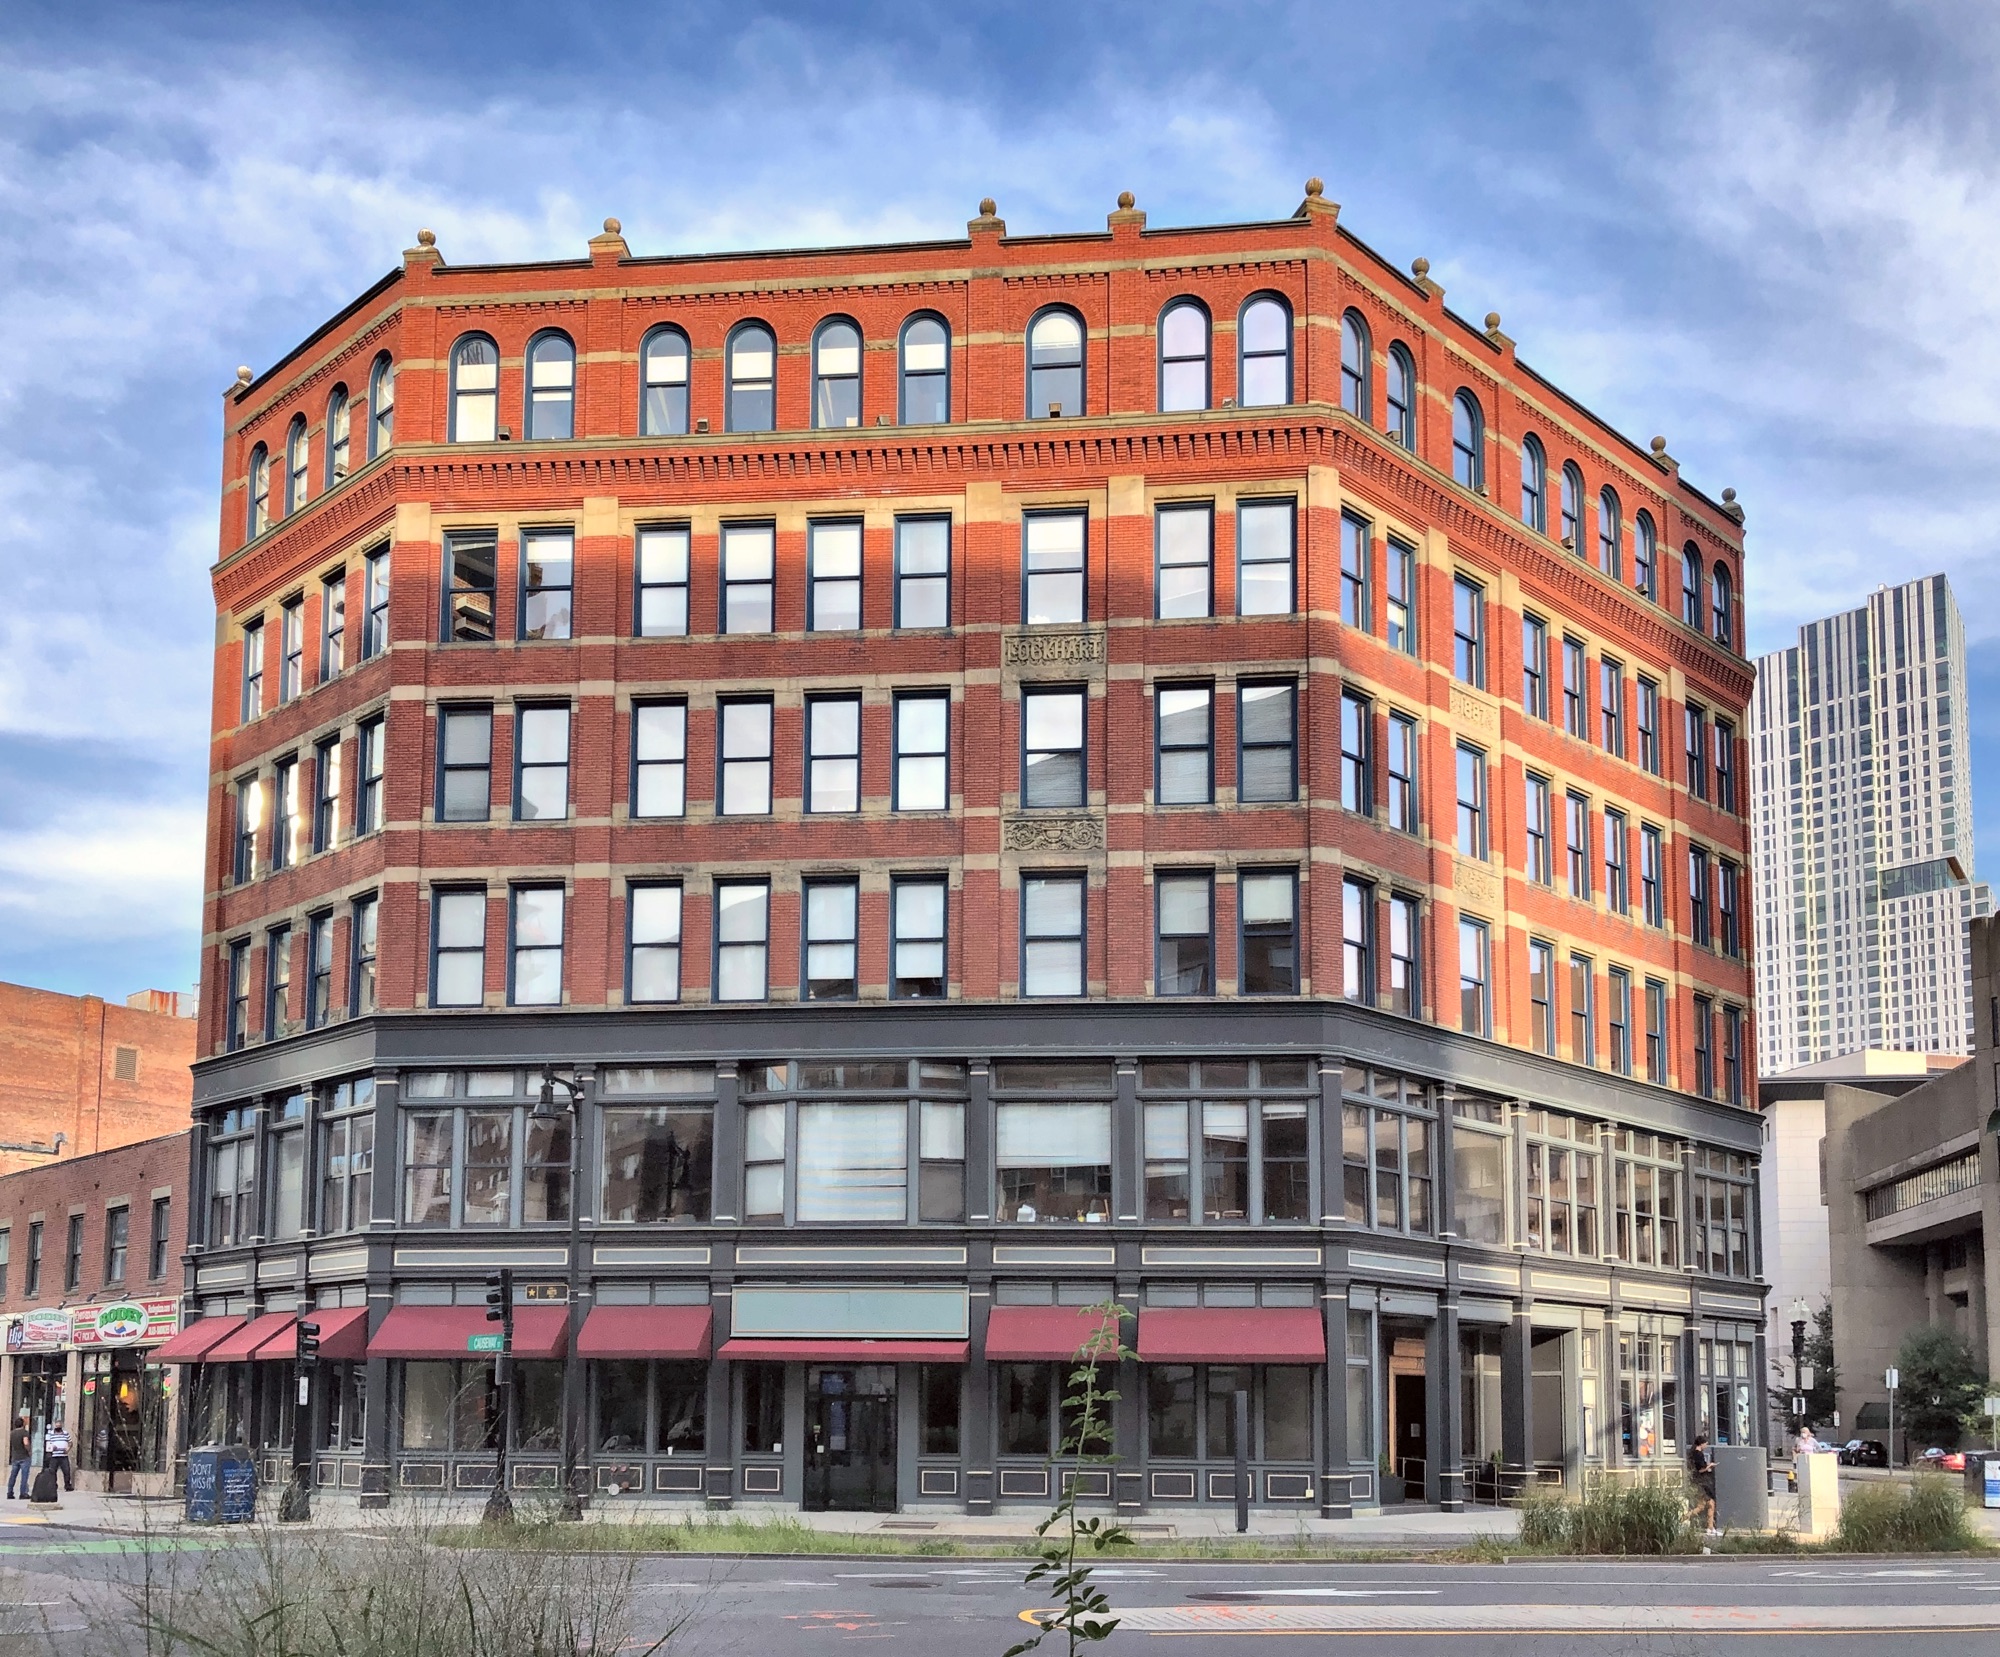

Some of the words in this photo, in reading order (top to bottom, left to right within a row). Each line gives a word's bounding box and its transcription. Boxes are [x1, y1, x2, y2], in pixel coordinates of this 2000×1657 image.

[1006, 637, 1101, 661] LOCKHART
[8, 1326, 23, 1348] Hig
[474, 1337, 498, 1350] CAUSEWAY
